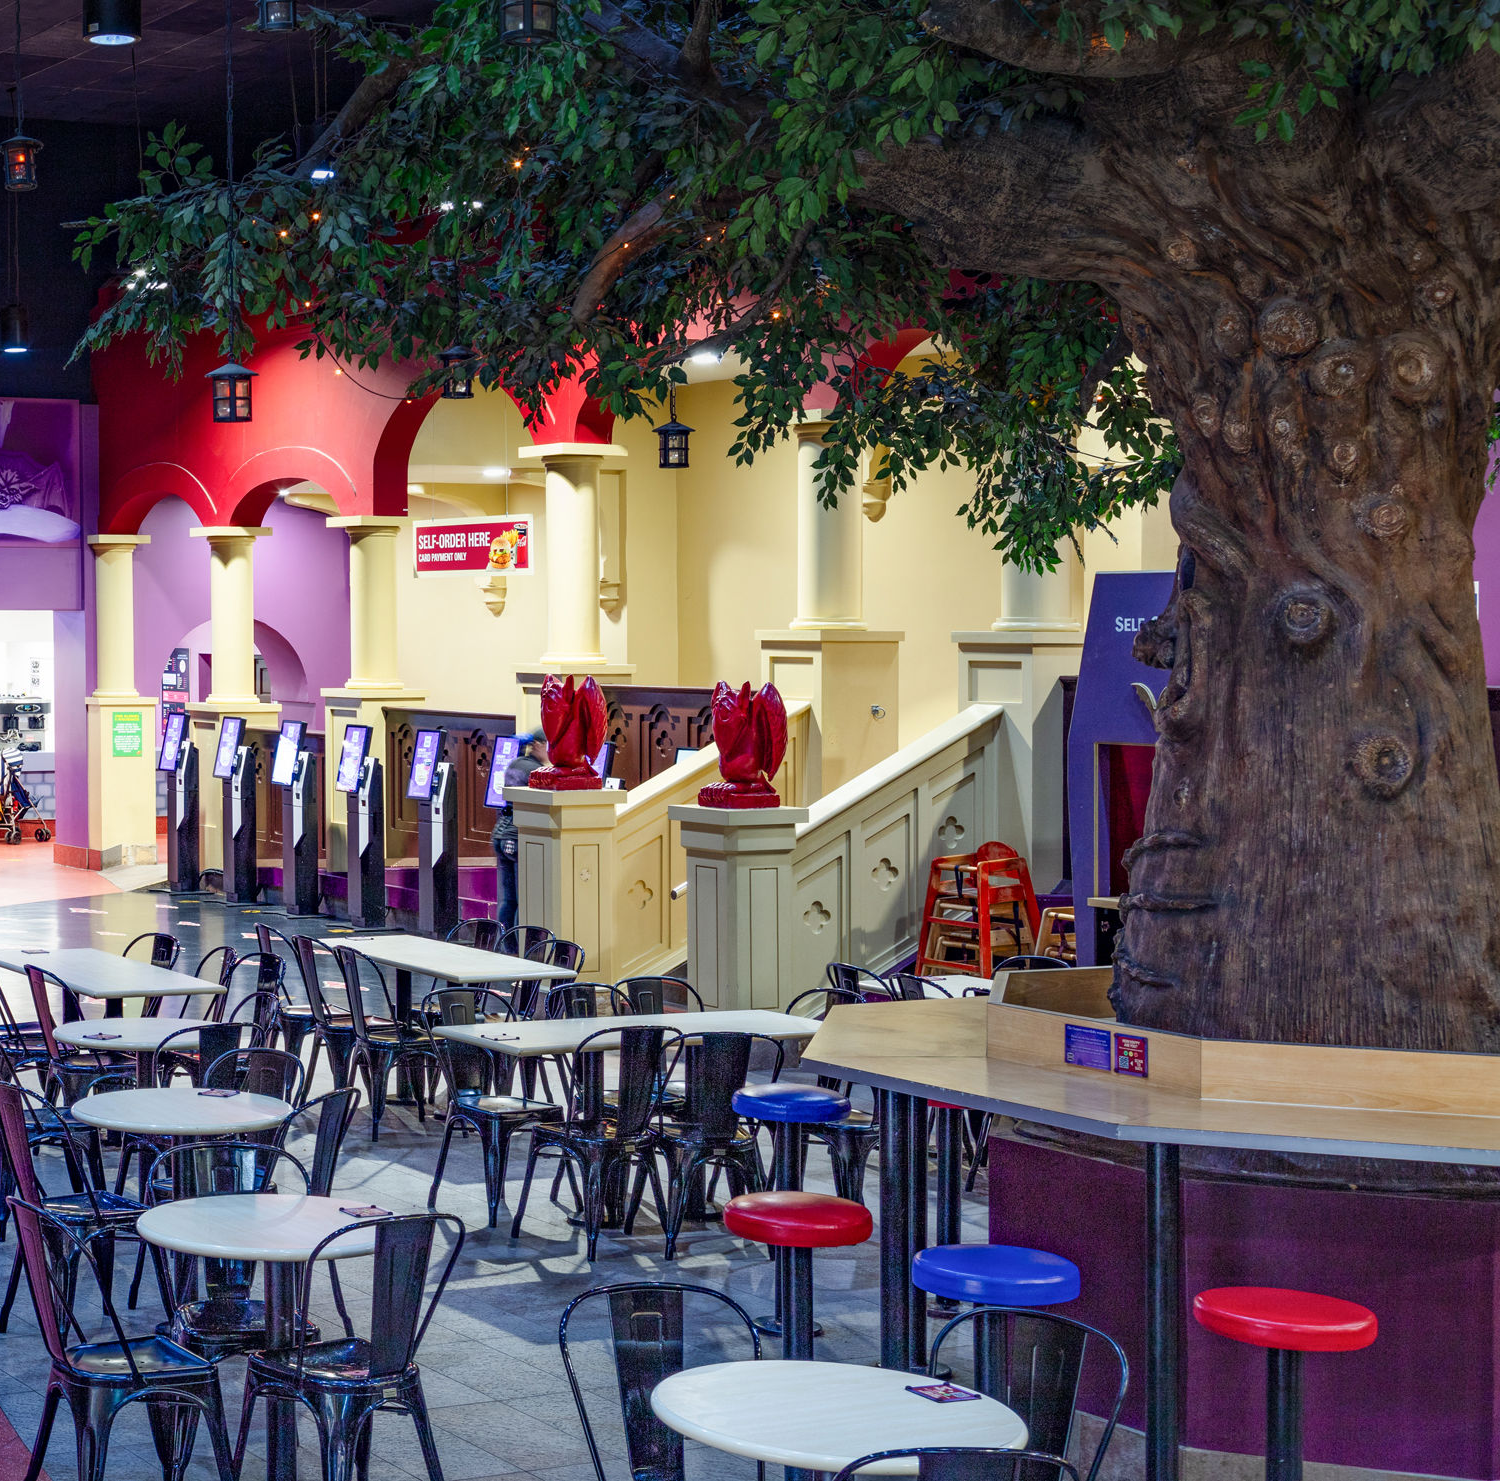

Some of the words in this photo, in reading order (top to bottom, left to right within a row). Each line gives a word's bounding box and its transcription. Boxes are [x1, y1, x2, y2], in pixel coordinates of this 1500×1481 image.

[419, 533, 466, 549] SELF-ORDER
[468, 531, 490, 547] HERE
[419, 553, 430, 562] CARD
[431, 552, 453, 562] PAYMENT
[454, 552, 467, 561] ONLY
